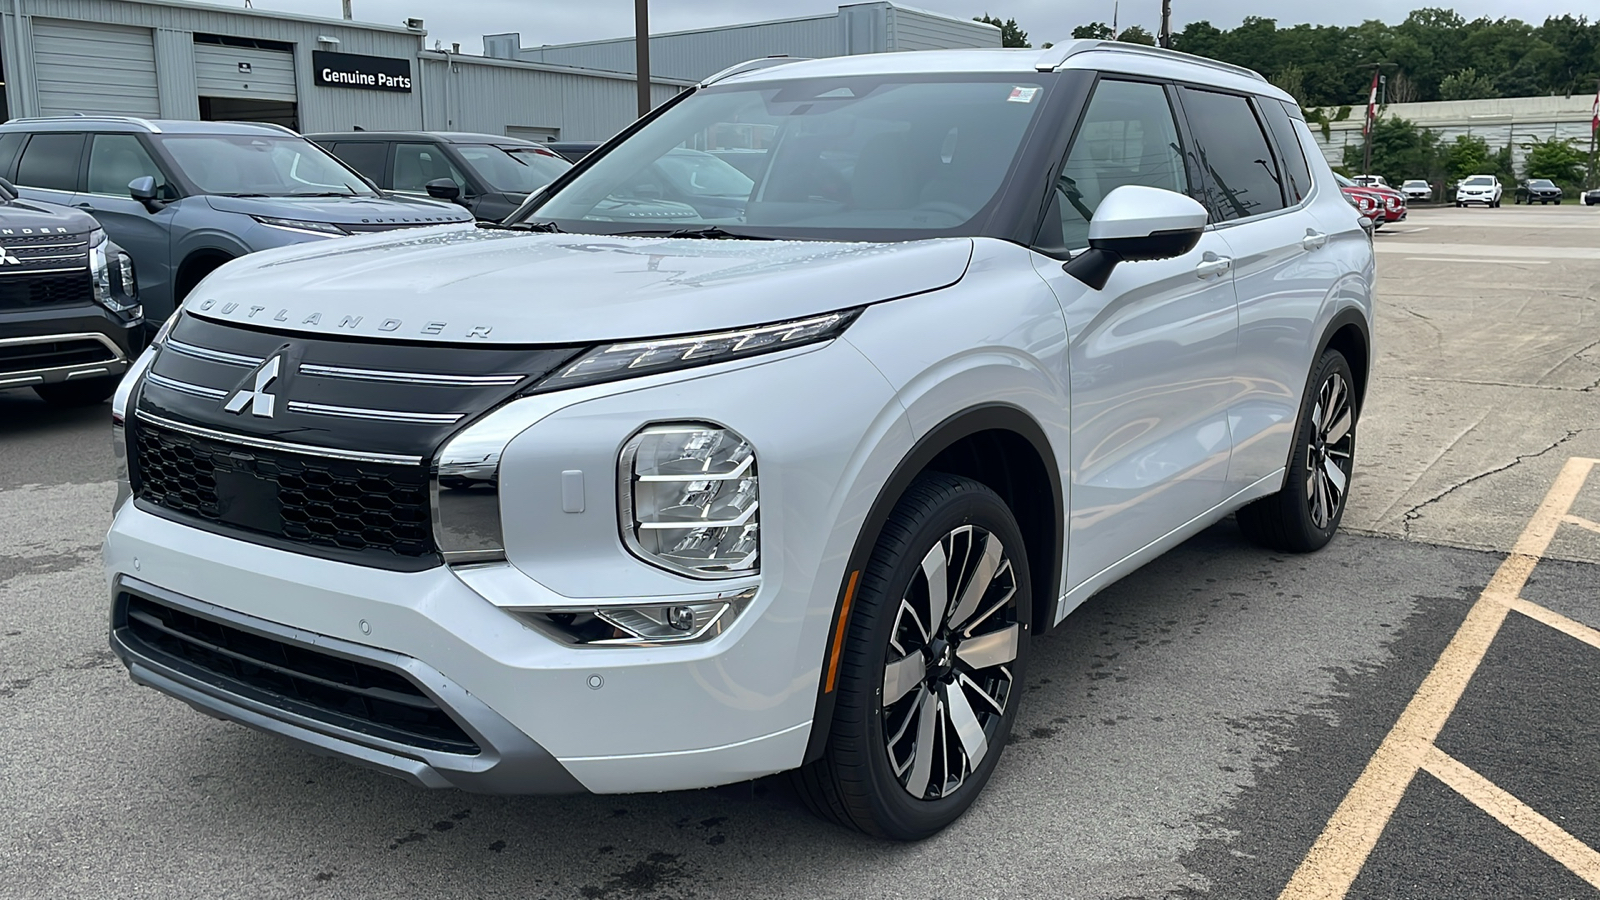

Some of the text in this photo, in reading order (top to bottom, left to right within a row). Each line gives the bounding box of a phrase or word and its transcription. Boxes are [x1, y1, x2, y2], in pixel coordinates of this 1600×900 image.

[322, 68, 411, 88] Genuine Parts
[200, 298, 494, 338] OUTLANDER
